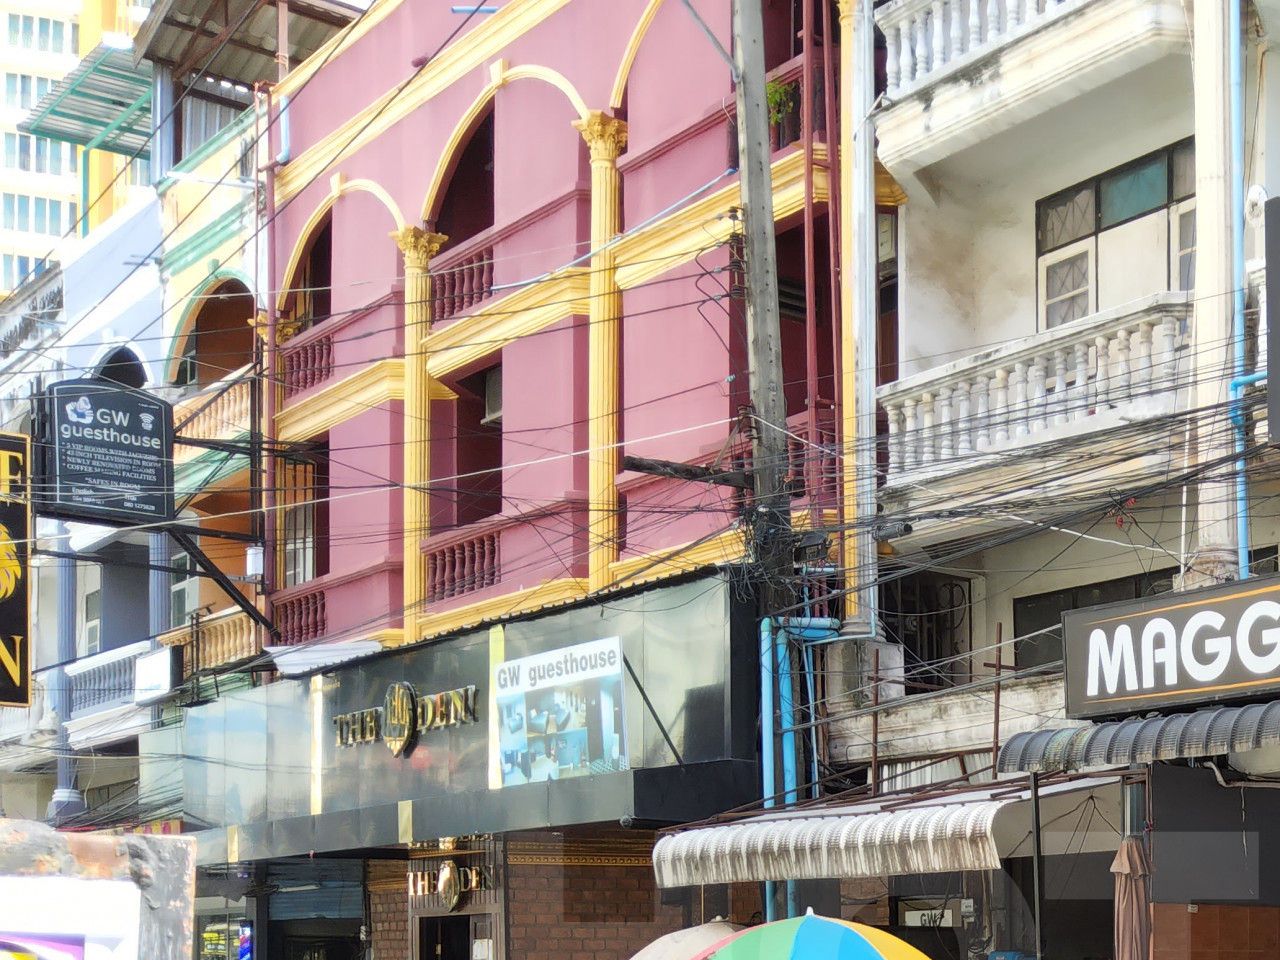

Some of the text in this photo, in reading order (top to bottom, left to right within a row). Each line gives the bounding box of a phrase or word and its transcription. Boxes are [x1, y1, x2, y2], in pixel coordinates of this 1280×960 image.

[96, 408, 130, 428] GW
[61, 423, 161, 450] guesthouse
[497, 648, 617, 689] GW guesthouse
[333, 685, 478, 748] THE DEN
[407, 863, 494, 896] THE DEN
